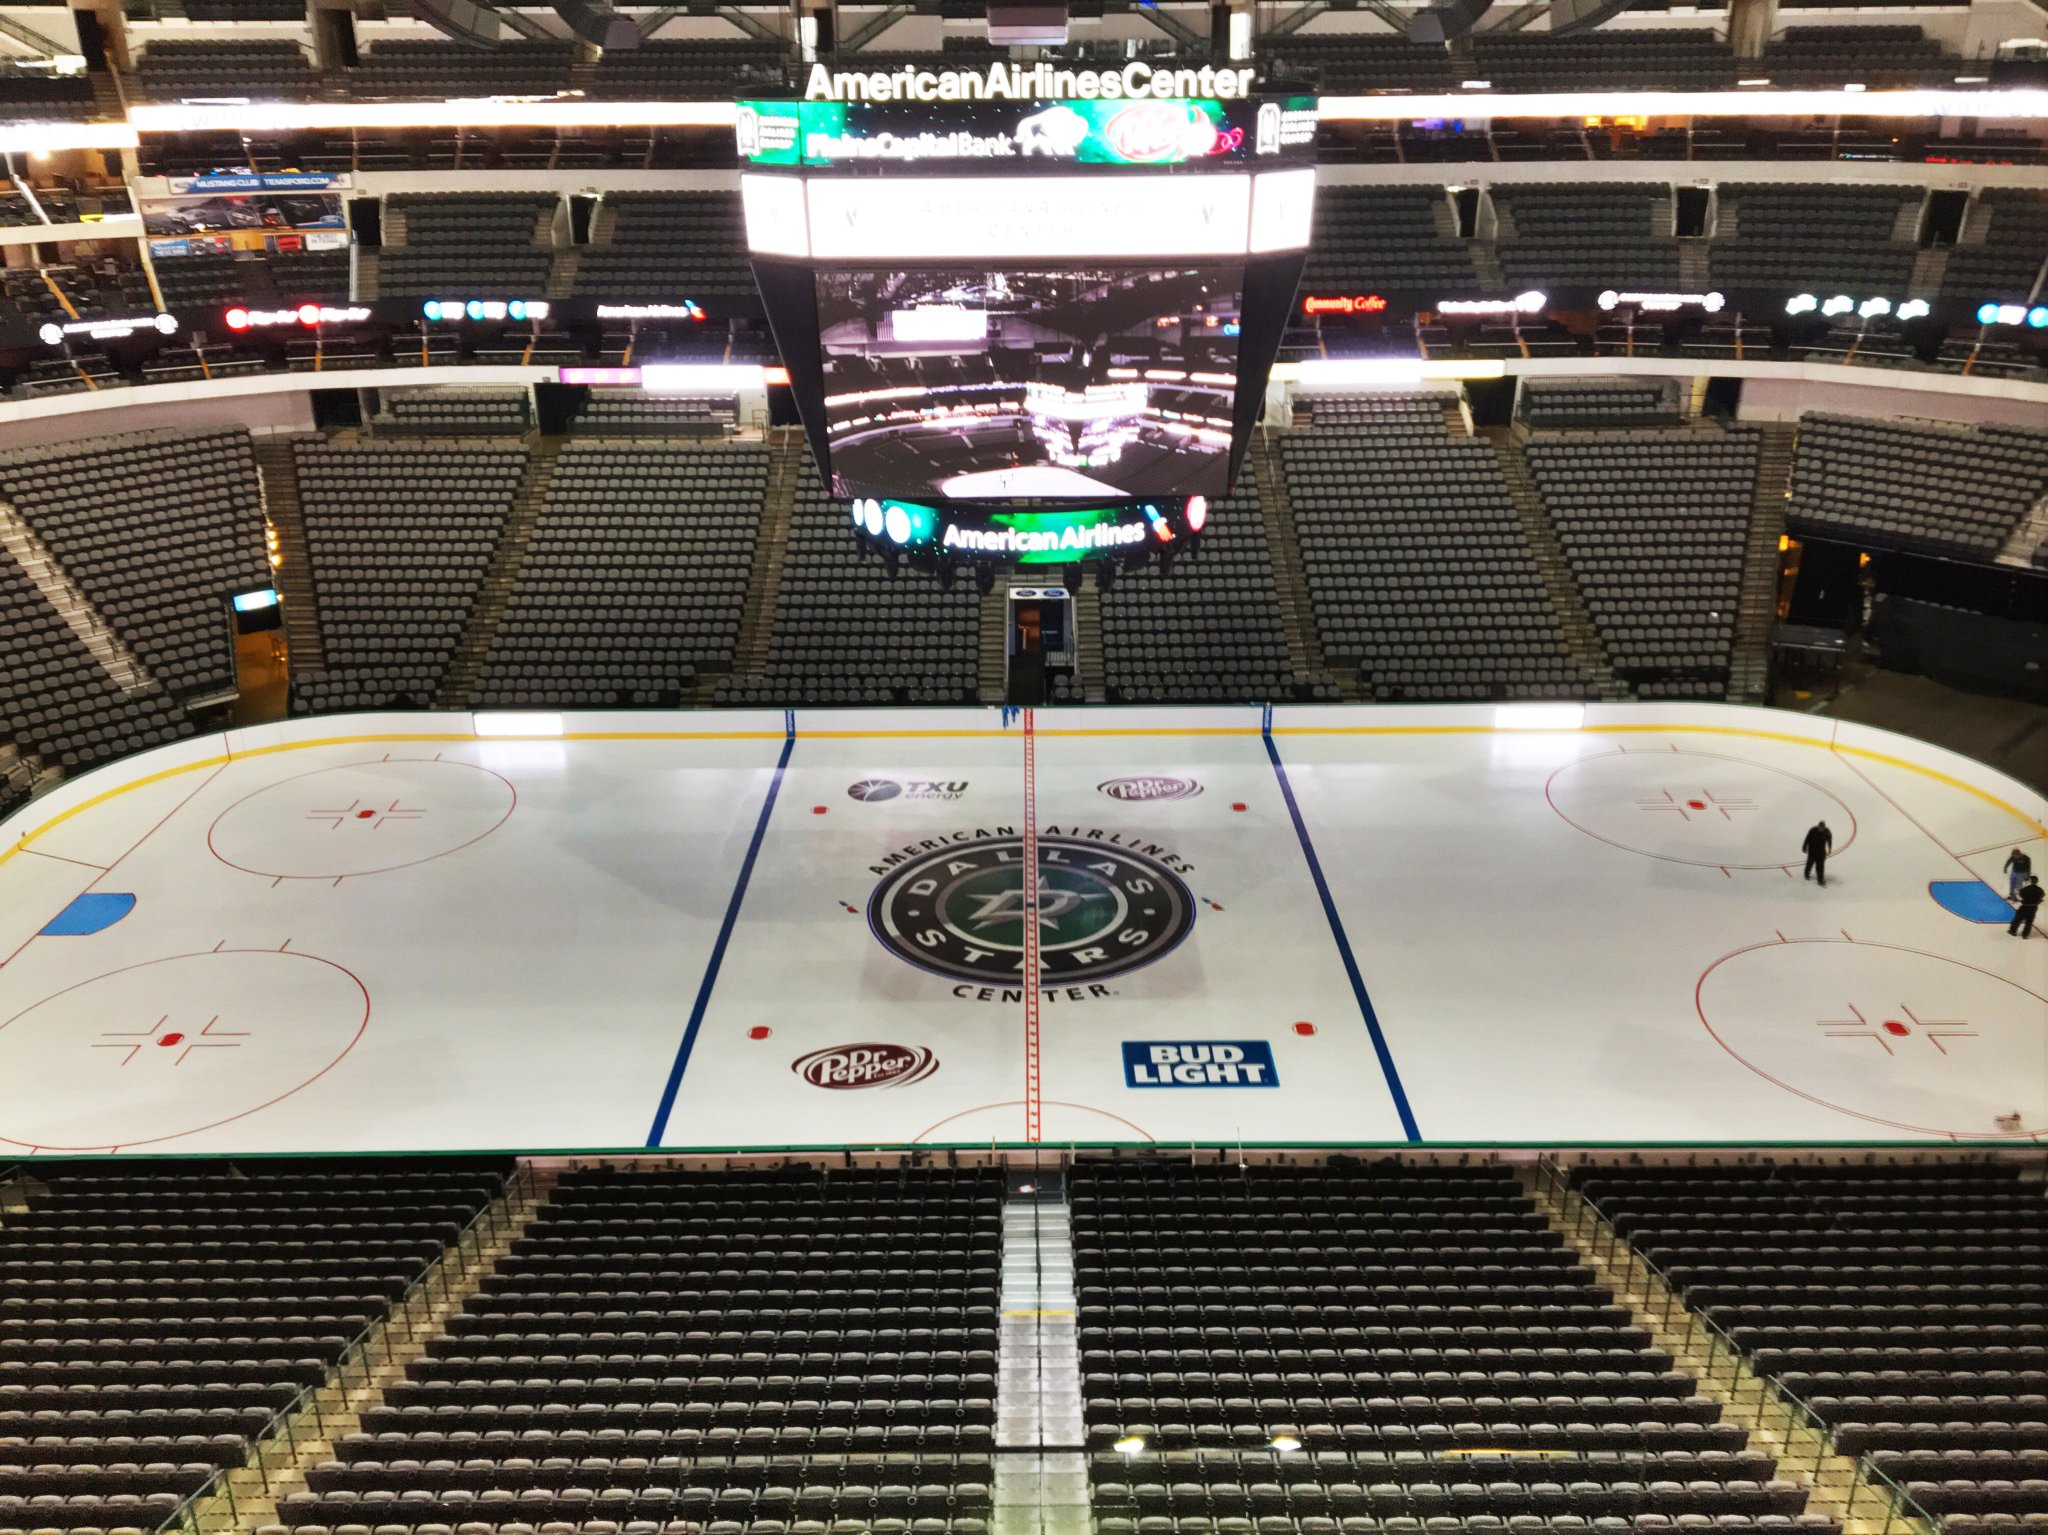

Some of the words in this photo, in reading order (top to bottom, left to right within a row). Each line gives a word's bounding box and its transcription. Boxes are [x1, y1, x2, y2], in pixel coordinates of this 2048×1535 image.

[943, 524, 1059, 551] American
[1059, 522, 1145, 549] Airlines
[905, 792, 964, 800] energy
[907, 781, 969, 792] TXU
[868, 826, 1015, 876] AMERICAN
[1045, 825, 1195, 874] AIRLINES
[907, 849, 1154, 896] DALLAS
[952, 984, 1111, 1004] CENTER
[849, 1050, 887, 1066] Dr
[1150, 1045, 1245, 1064] BUD
[819, 1054, 911, 1085] Pepper
[1133, 1063, 1266, 1084] LIGHT
